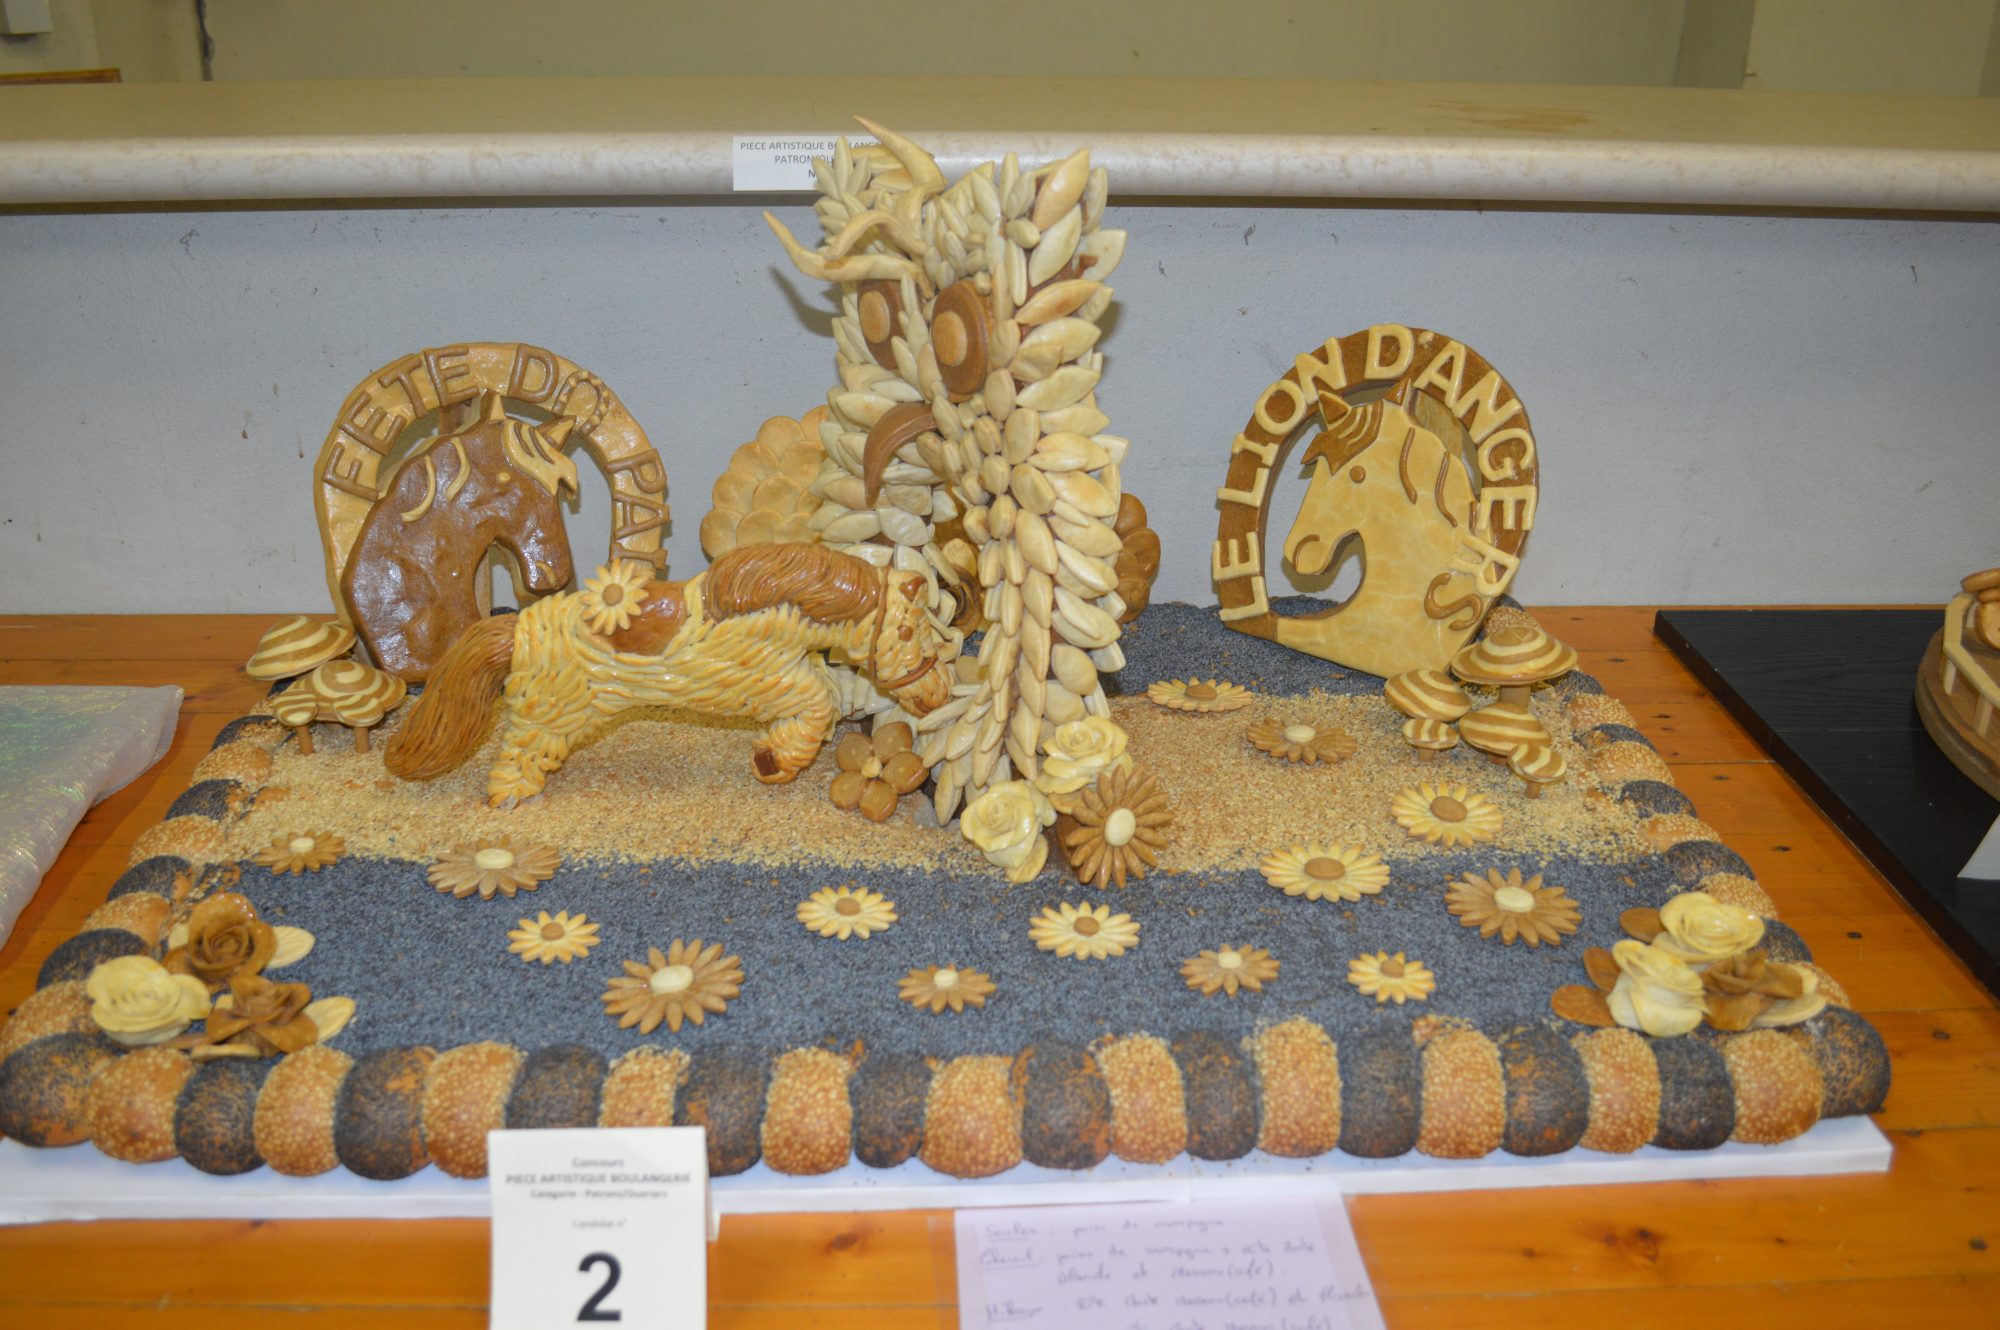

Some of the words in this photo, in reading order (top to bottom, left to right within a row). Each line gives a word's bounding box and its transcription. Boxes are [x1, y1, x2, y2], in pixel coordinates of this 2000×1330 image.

[740, 141, 767, 150] PIECE
[769, 141, 825, 151] ARTISTIQUE
[1216, 336, 1347, 508] LION
[604, 448, 671, 570] PAI
[1212, 531, 1270, 622] LE
[505, 1173, 537, 1184] PIECE
[540, 1173, 607, 1184] ARTISTIQUE
[611, 1172, 691, 1184] BOULANGERIE
[572, 1157, 625, 1168] Concours
[572, 1218, 614, 1229] Candidat
[576, 1251, 622, 1322] 2
